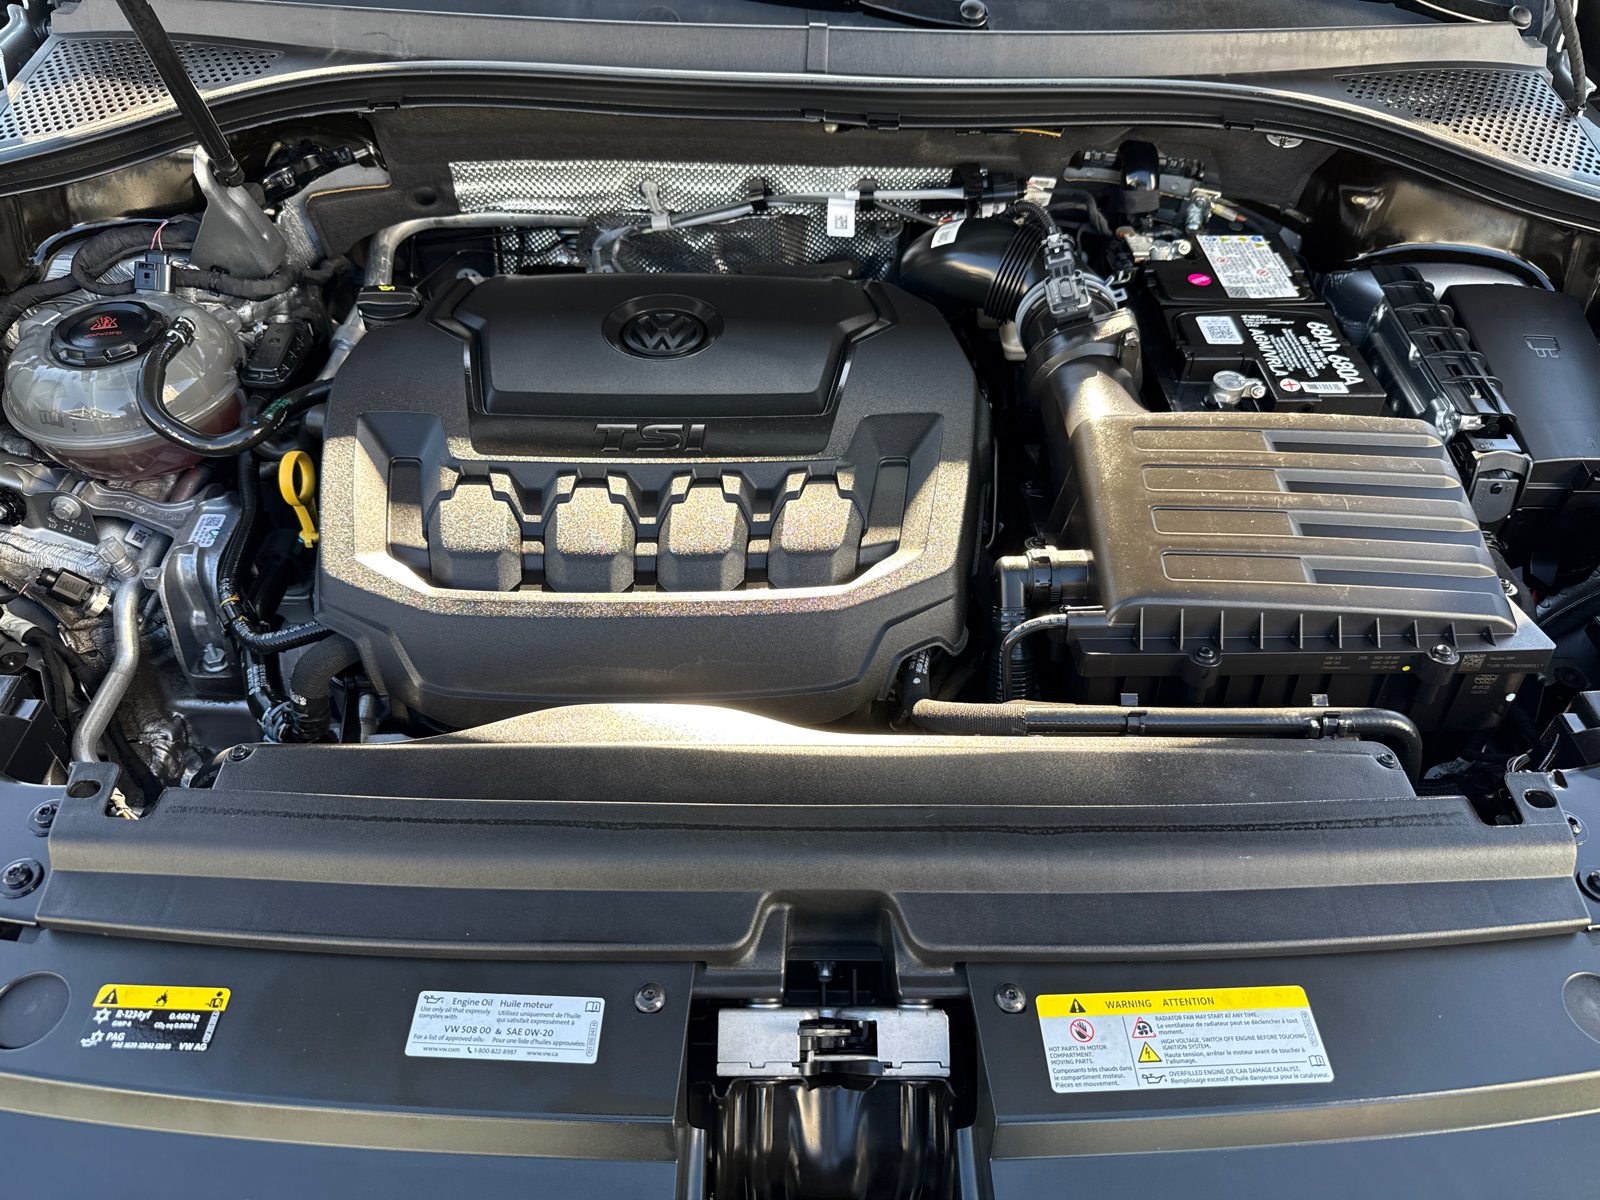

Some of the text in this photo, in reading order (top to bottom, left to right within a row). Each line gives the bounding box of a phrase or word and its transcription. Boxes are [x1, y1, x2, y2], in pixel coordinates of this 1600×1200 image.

[1307, 321, 1341, 352] 68Ah
[1328, 354, 1364, 386] 680A
[594, 424, 706, 451] TSI
[453, 998, 479, 1007] Engine
[1105, 997, 1215, 1009] WARNING ATTENTION
[115, 1010, 152, 1021] R-1234yf
[191, 1014, 200, 1022] kg
[106, 1032, 125, 1041] PAG
[524, 1028, 554, 1036] 0W-20
[1052, 1066, 1088, 1075] Composants
